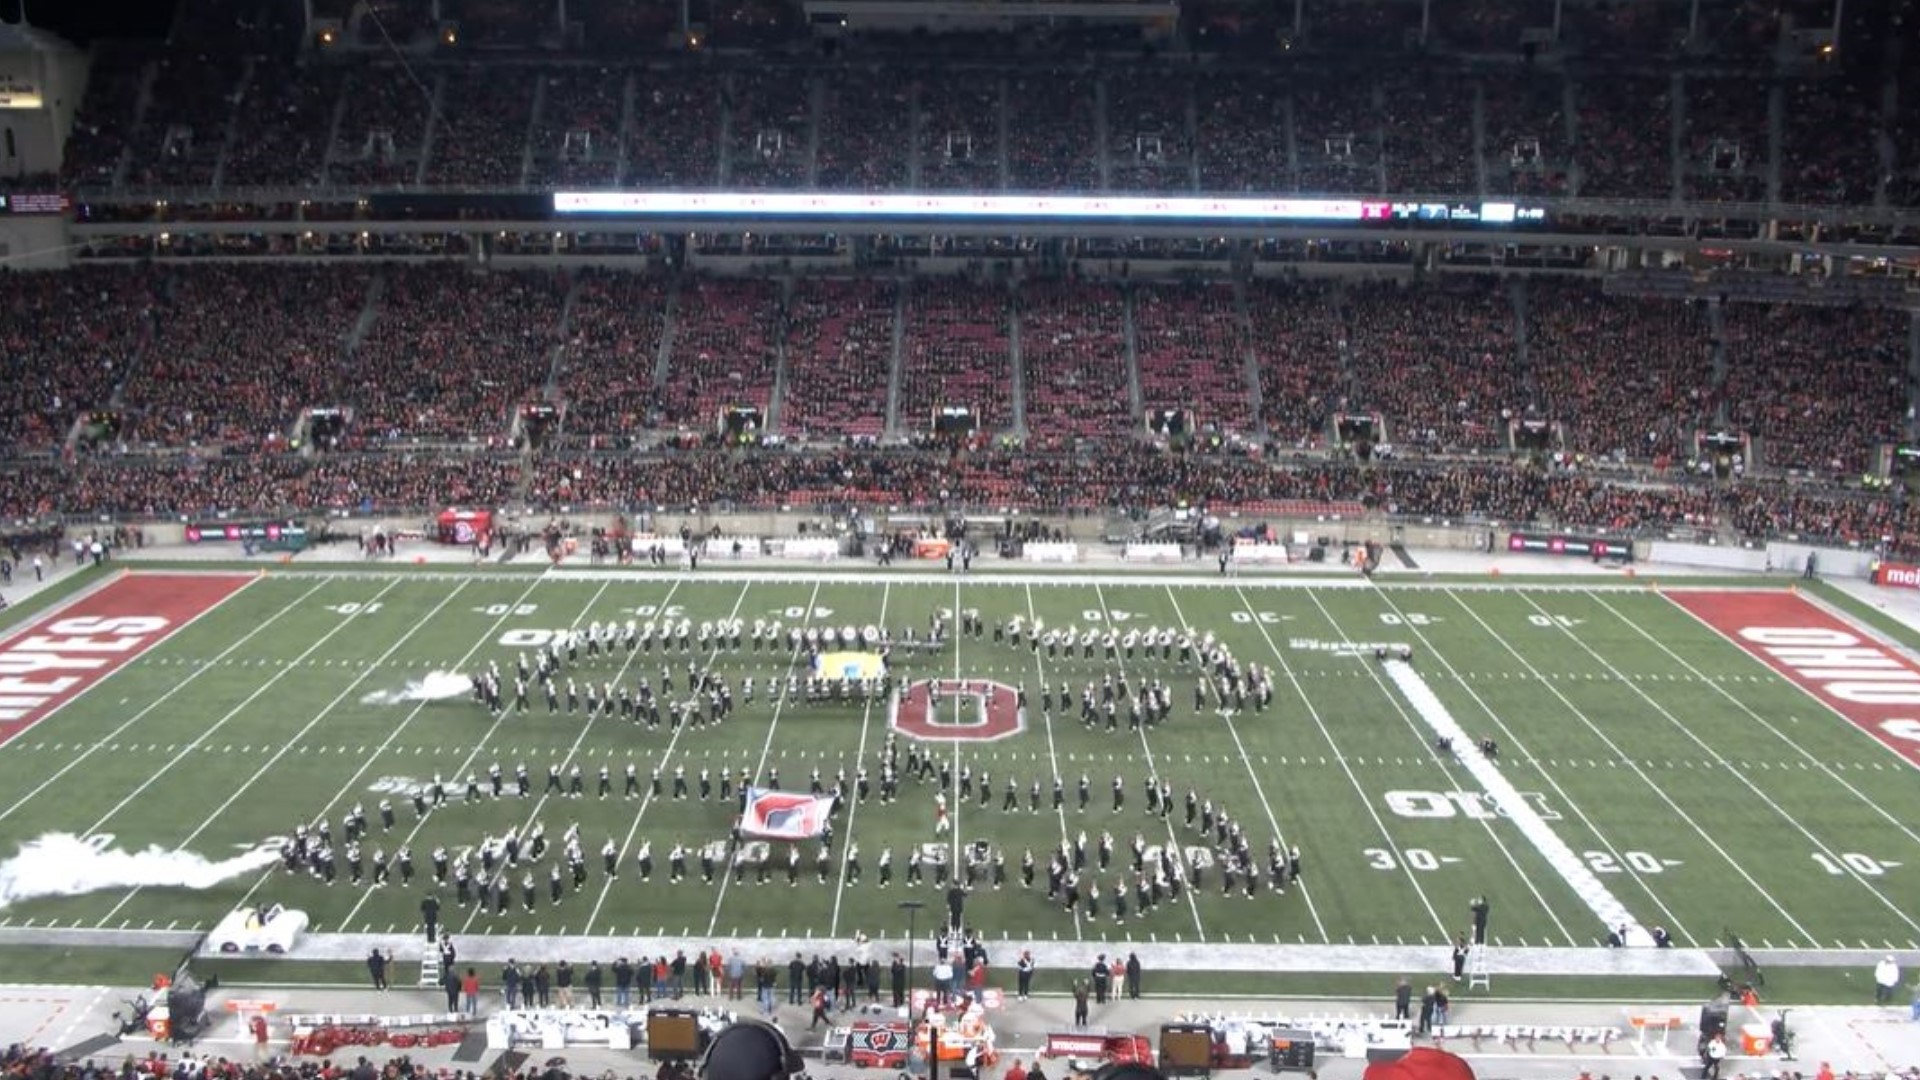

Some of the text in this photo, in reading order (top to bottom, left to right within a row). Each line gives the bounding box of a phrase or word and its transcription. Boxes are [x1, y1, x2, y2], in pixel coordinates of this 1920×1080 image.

[1737, 626, 1920, 704] OHIO
[1363, 848, 1440, 870] 30
[1583, 850, 1664, 873] 20
[1811, 853, 1885, 875] 10
